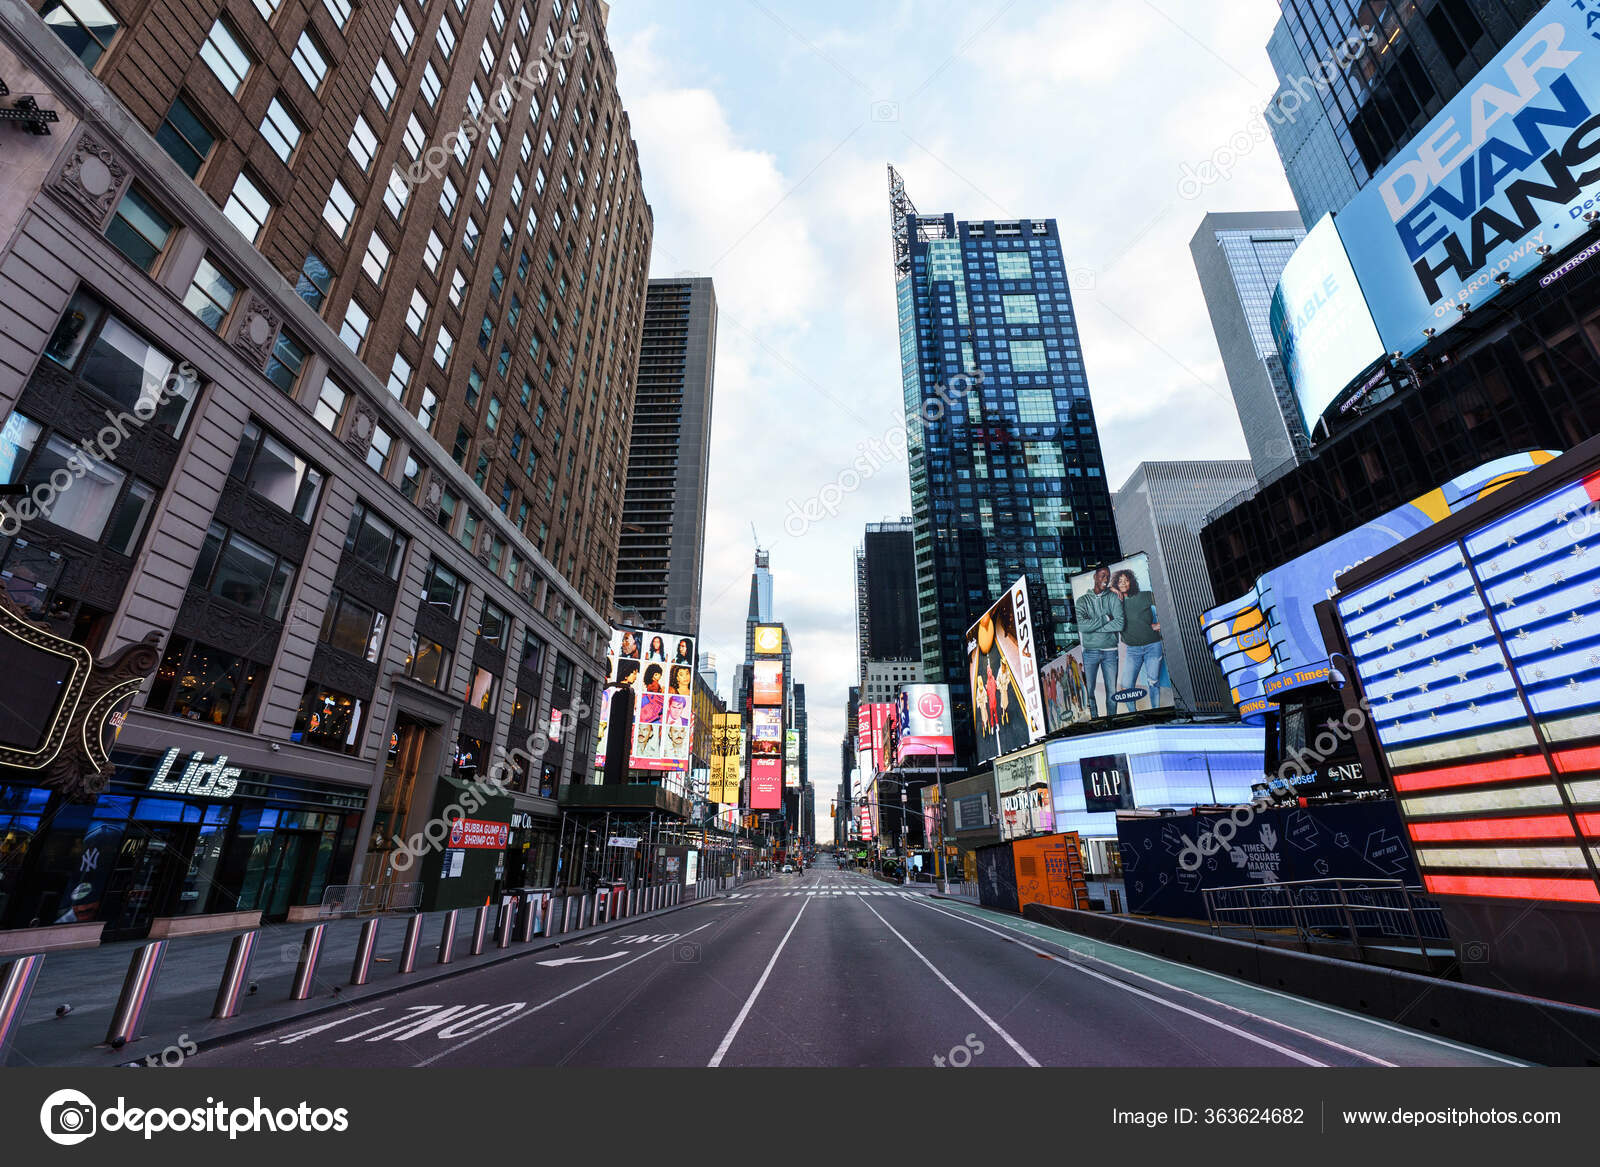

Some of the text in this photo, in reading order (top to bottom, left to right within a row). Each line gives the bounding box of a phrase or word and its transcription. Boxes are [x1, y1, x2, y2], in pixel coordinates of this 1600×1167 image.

[1378, 22, 1583, 223] DEAR
[1395, 73, 1591, 263] EVAN
[1412, 114, 1600, 306] HANS
[1434, 299, 1456, 318] ON
[1457, 231, 1544, 303] BROADWAY
[1268, 667, 1329, 692] Live in Times
[1127, 690, 1143, 699] NAVY
[923, 720, 943, 735] LG
[149, 747, 242, 798] Lids
[1339, 763, 1363, 780] NE
[1091, 769, 1121, 799] GAP
[1005, 796, 1018, 812] OLD
[464, 823, 500, 835] BUBBA GUMP
[464, 835, 496, 846] SHRIMP CO.
[1242, 844, 1265, 852] TIMES
[1249, 852, 1280, 862] SQUARE
[1247, 862, 1279, 871] MARKET
